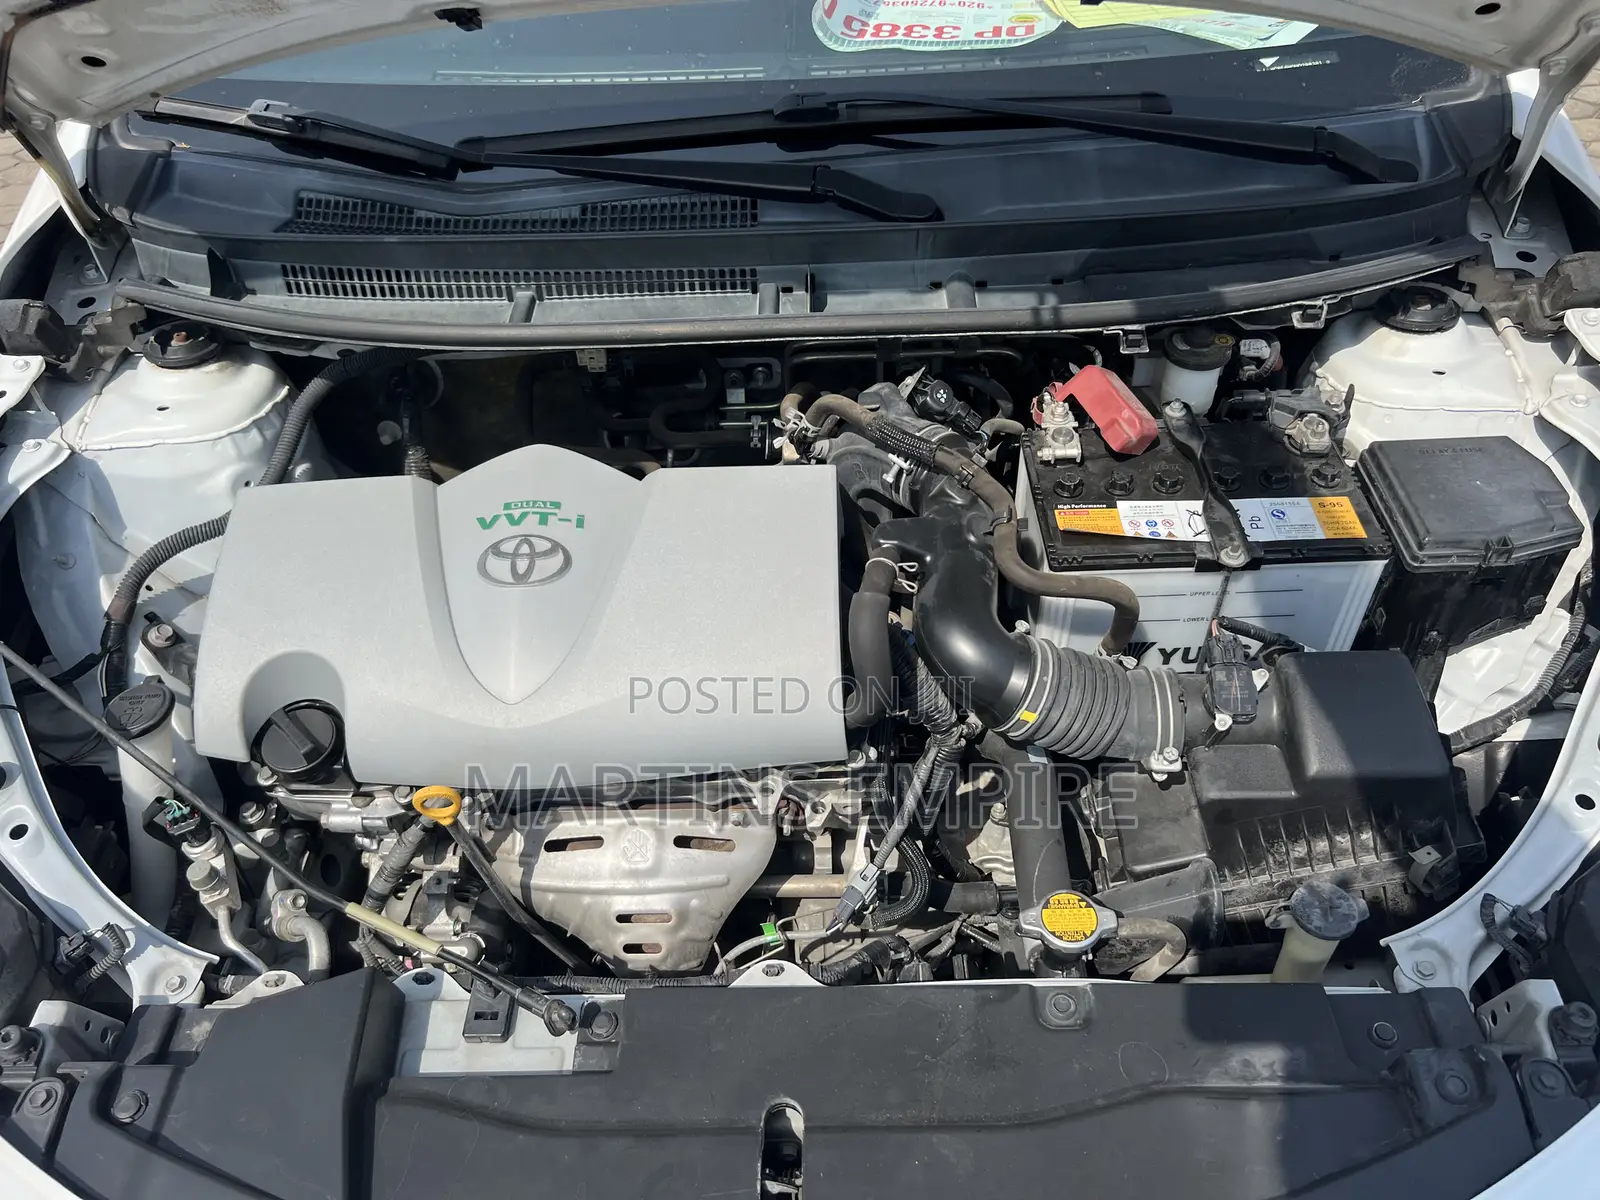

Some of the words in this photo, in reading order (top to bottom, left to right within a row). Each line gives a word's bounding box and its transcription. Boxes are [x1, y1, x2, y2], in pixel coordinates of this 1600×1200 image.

[840, 15, 962, 39] 3385
[974, 24, 1035, 38] DP
[511, 501, 556, 509] DUAL
[1318, 501, 1344, 509] S-95
[476, 511, 585, 530] VVT-i
[1248, 515, 1264, 530] Pb
